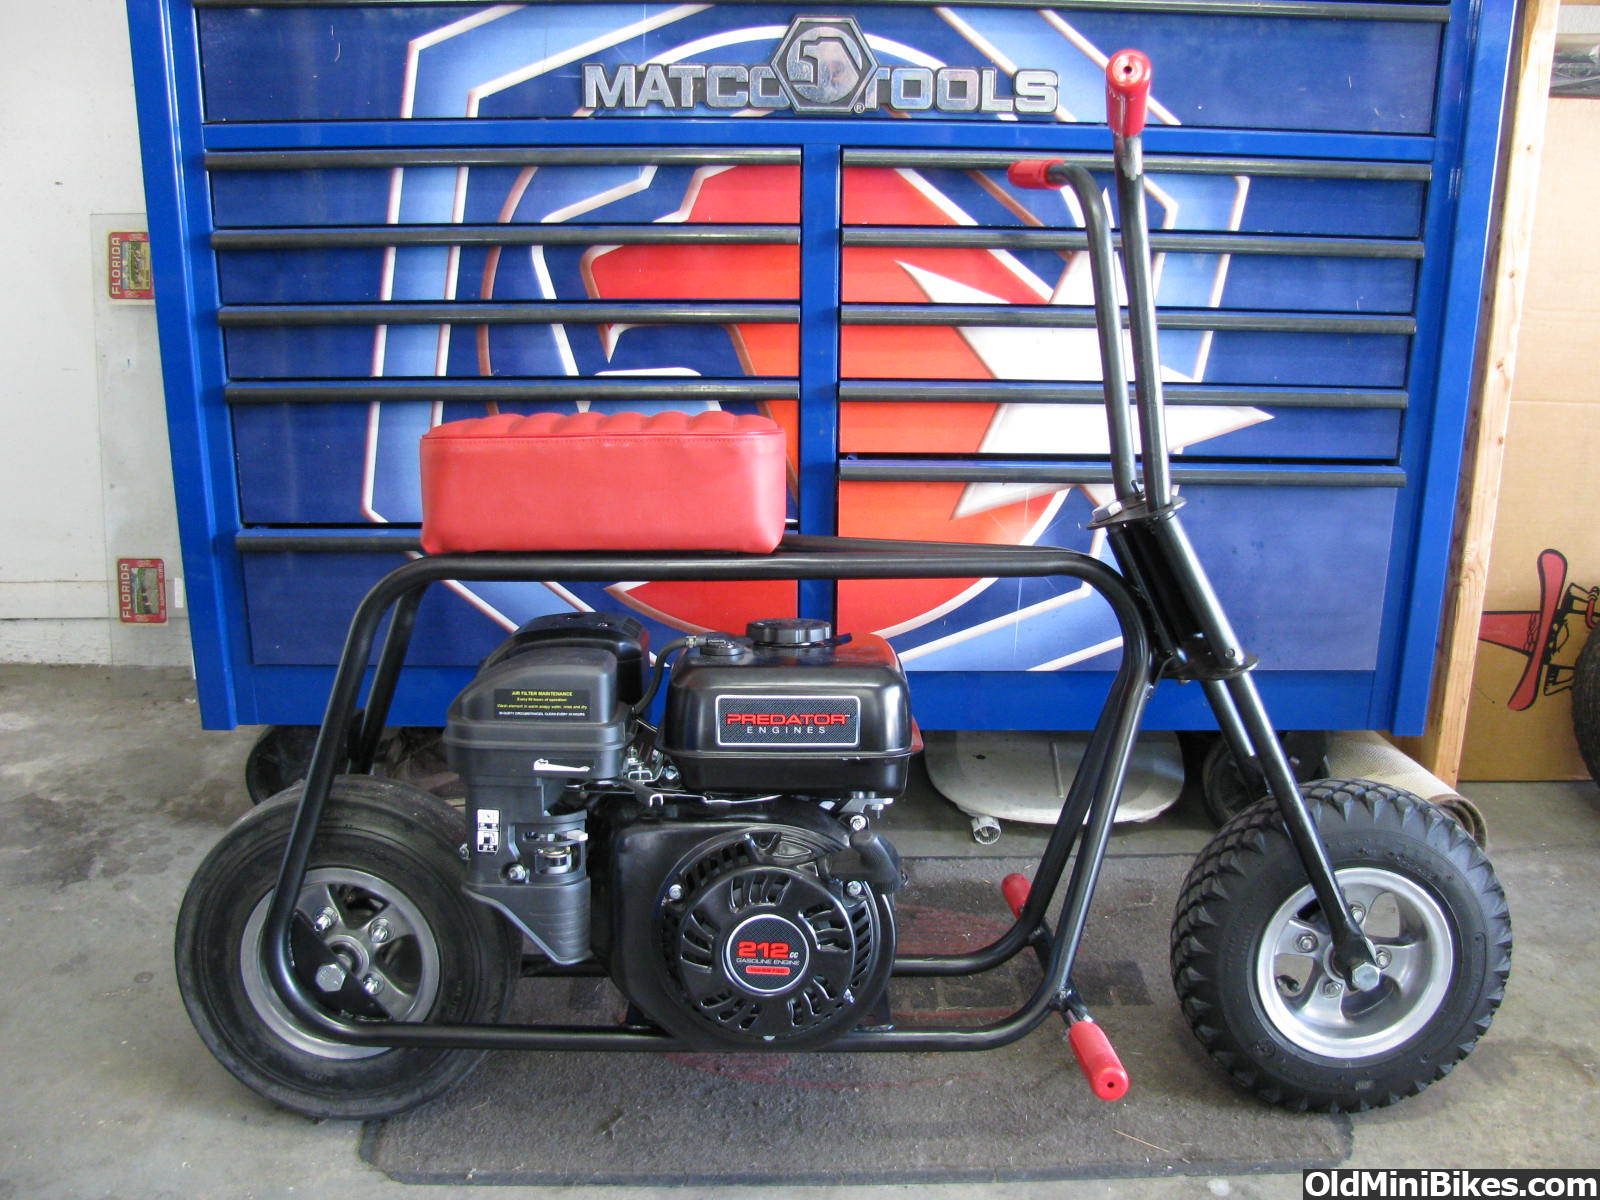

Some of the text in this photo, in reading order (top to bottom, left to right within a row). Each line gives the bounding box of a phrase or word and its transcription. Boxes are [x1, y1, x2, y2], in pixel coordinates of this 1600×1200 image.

[581, 63, 788, 110] MATCO
[111, 237, 121, 294] FLORIDA
[120, 564, 131, 618] FLORIDA
[726, 713, 847, 725] PREDATOR
[746, 726, 826, 734] ENGINES
